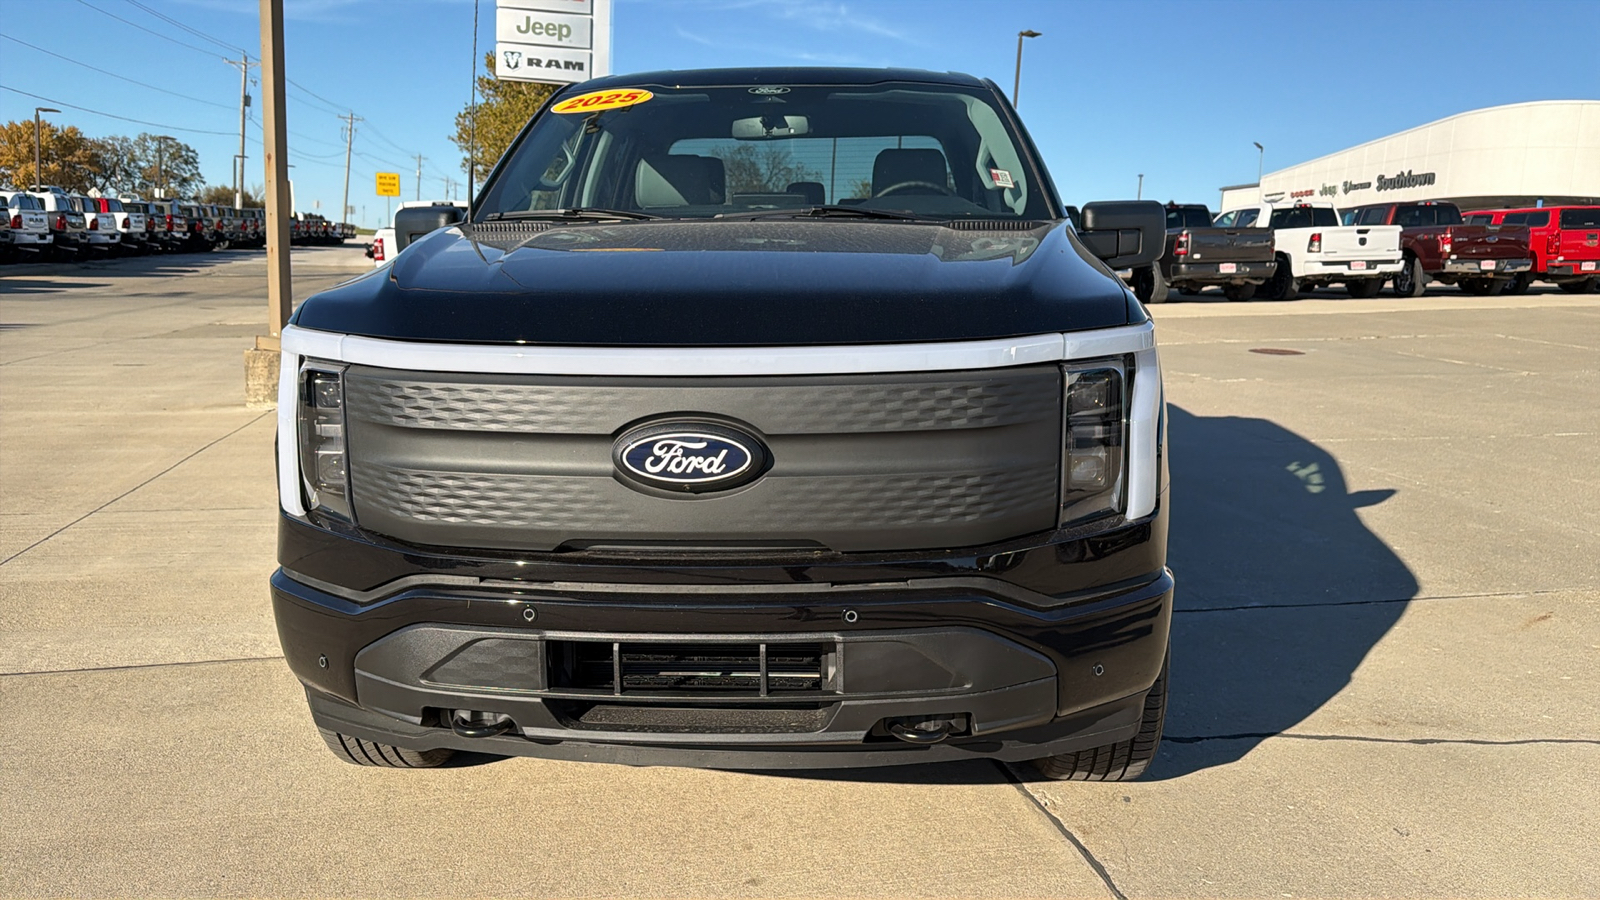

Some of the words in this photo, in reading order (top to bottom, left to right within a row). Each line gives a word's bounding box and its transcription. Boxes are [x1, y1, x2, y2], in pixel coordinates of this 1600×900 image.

[516, 16, 572, 41] Jeep
[527, 57, 584, 71] RAM
[560, 91, 644, 111] 2025
[1290, 189, 1315, 199] DODGE
[1319, 182, 1338, 198] Jeep
[1376, 170, 1436, 192] Southtown
[645, 440, 728, 474] Ford
